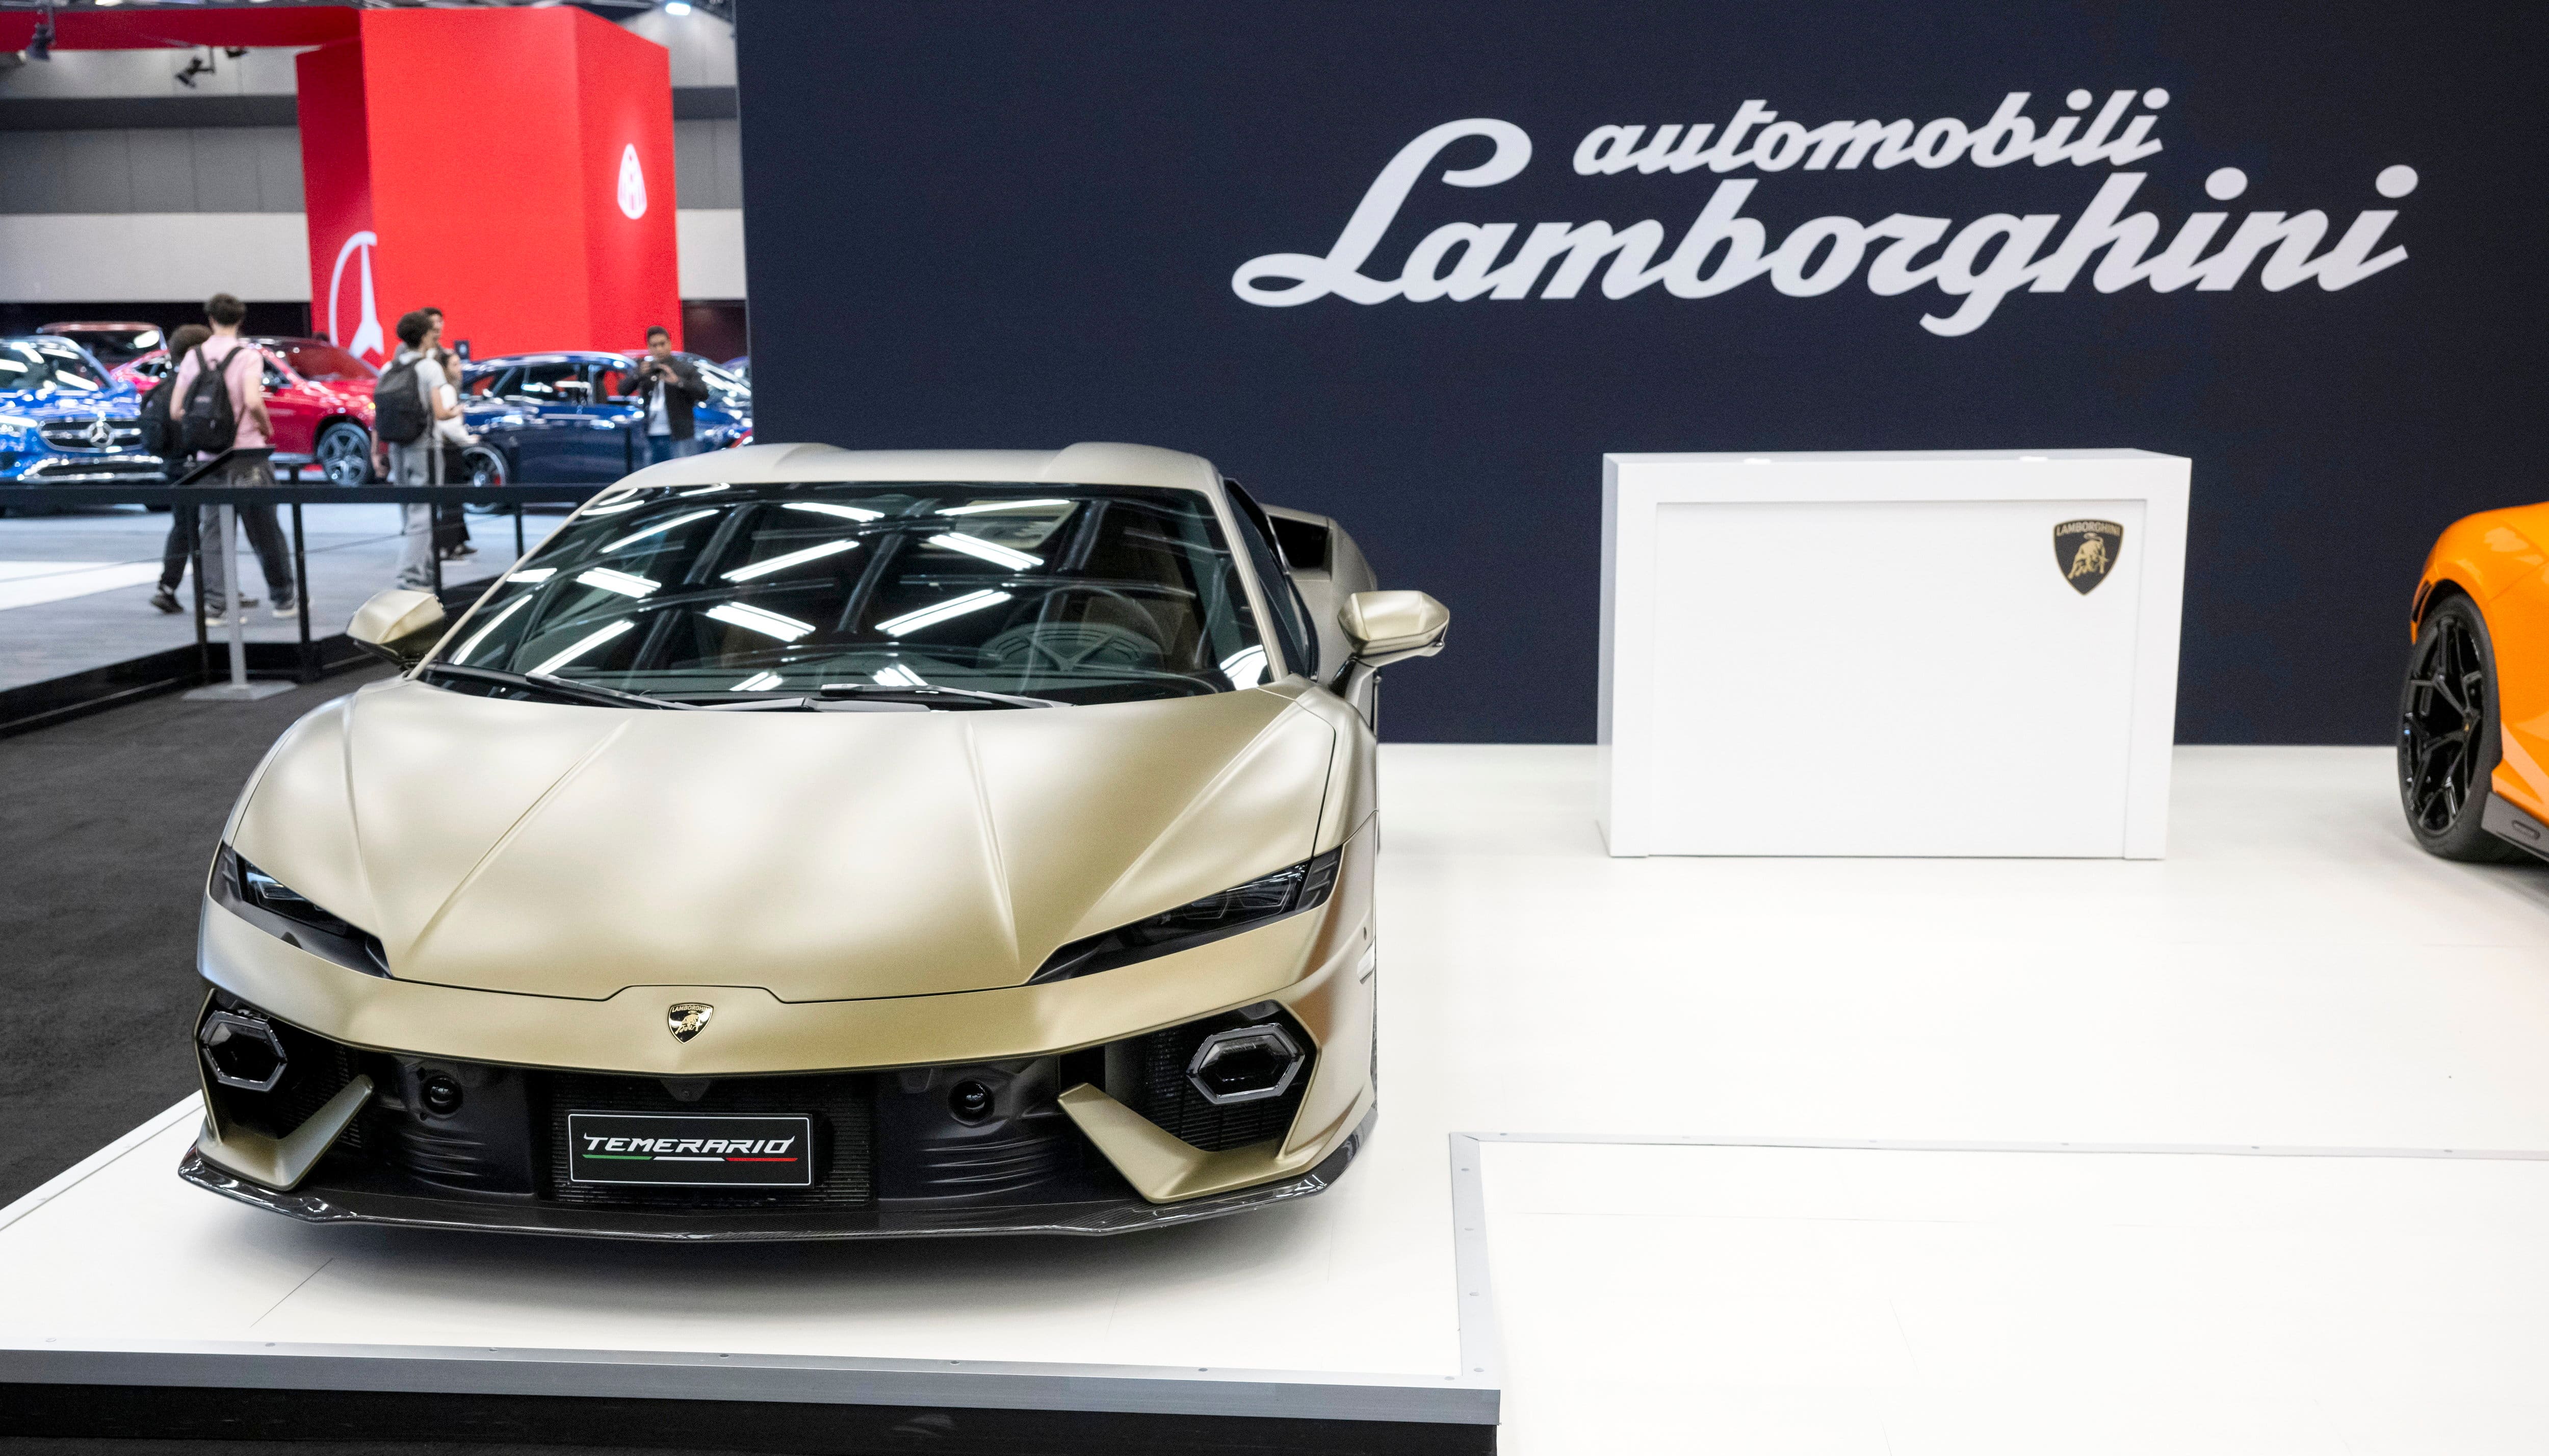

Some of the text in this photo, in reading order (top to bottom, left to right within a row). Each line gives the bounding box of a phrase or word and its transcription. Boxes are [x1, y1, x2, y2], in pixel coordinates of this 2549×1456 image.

[1573, 88, 2170, 175] automobili
[1232, 118, 2418, 337] Lamborghini
[584, 1132, 795, 1154] TEMERARIO
